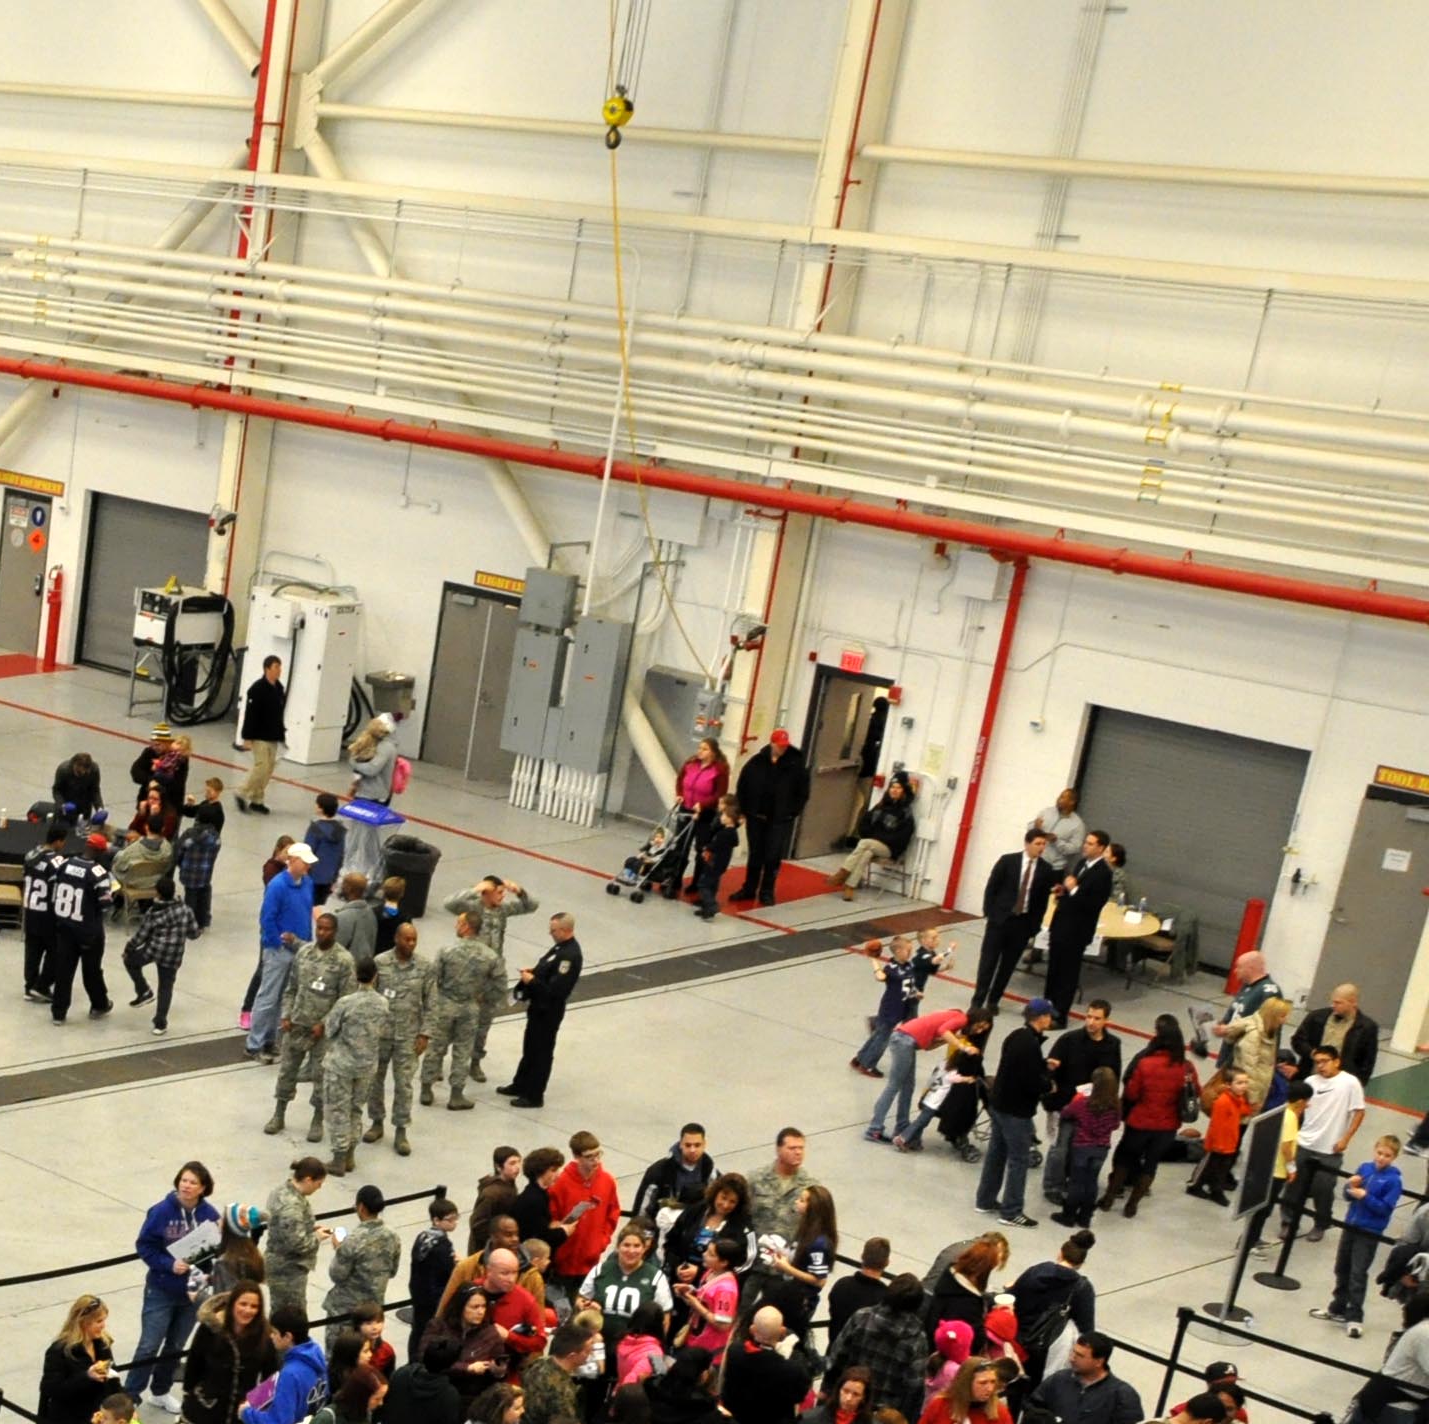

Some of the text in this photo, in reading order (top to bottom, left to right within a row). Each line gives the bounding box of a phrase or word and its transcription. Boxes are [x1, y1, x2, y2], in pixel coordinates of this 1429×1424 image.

[24, 875, 48, 912] 12
[54, 882, 84, 922] 81
[604, 1284, 641, 1316] 10
